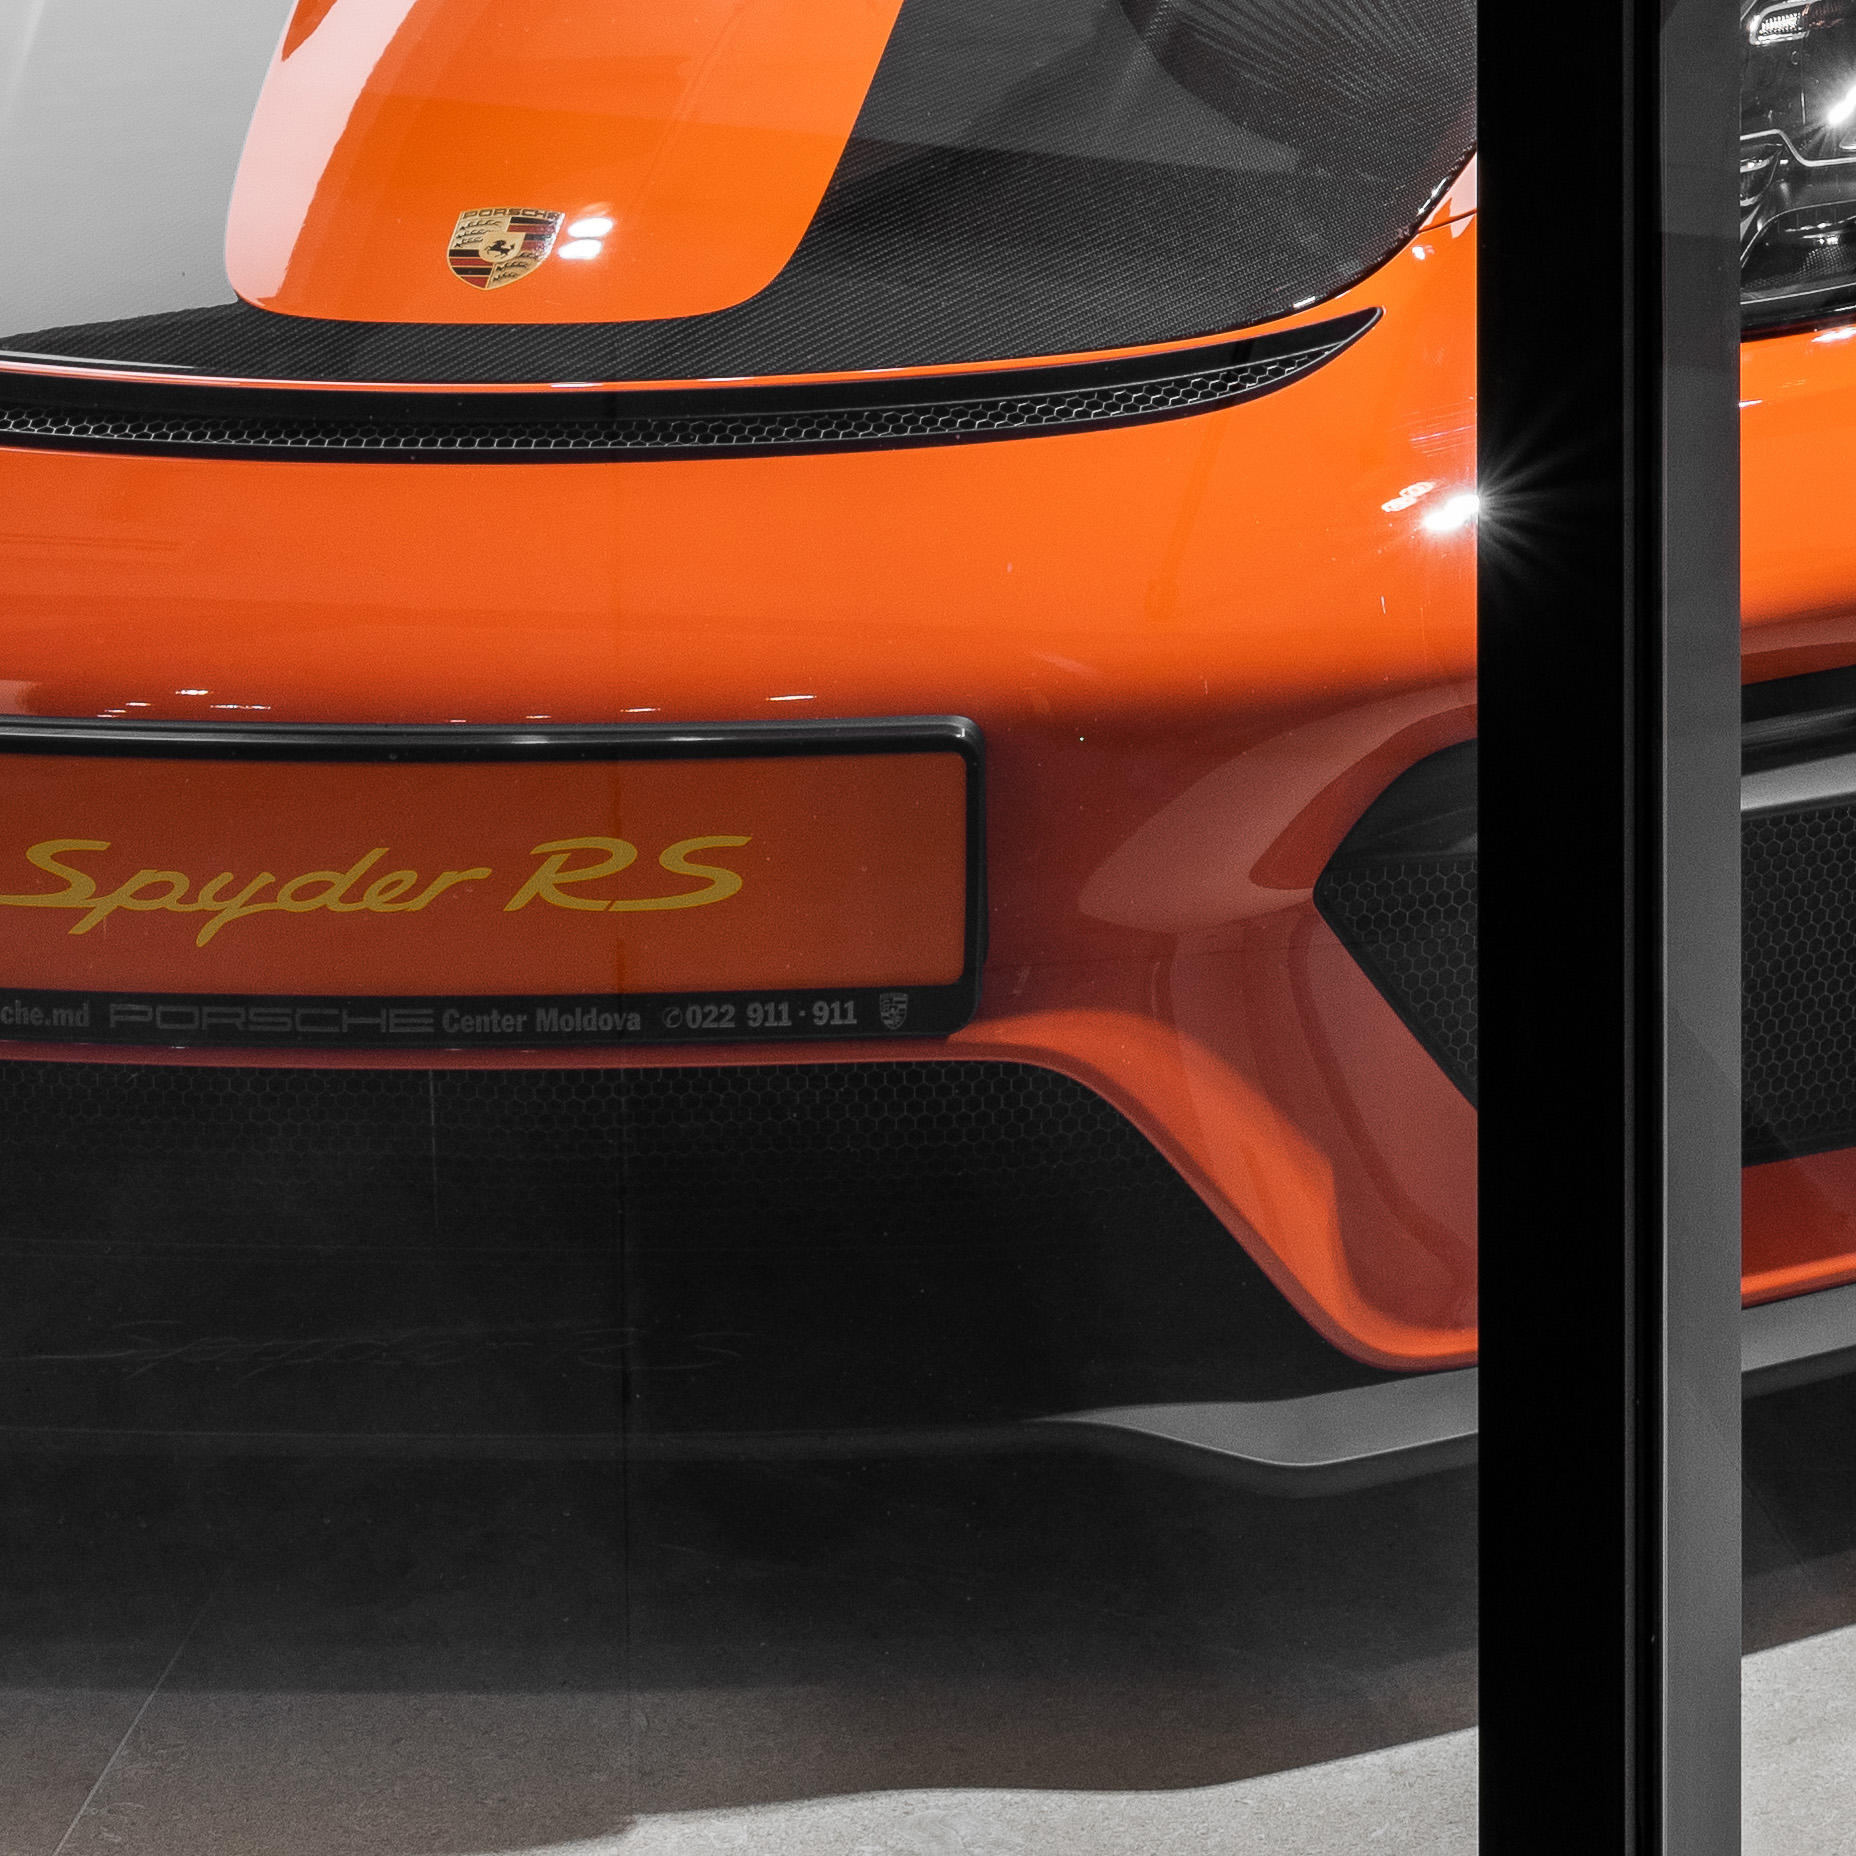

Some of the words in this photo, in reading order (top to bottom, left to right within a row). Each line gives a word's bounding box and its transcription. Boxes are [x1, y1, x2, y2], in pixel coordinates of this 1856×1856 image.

[0, 838, 493, 948] Spyder
[503, 835, 753, 913] RS
[108, 1003, 434, 1034] PORSCHE
[441, 1007, 528, 1034] Center
[535, 1007, 642, 1033] Moldova
[685, 1003, 736, 1029] 022
